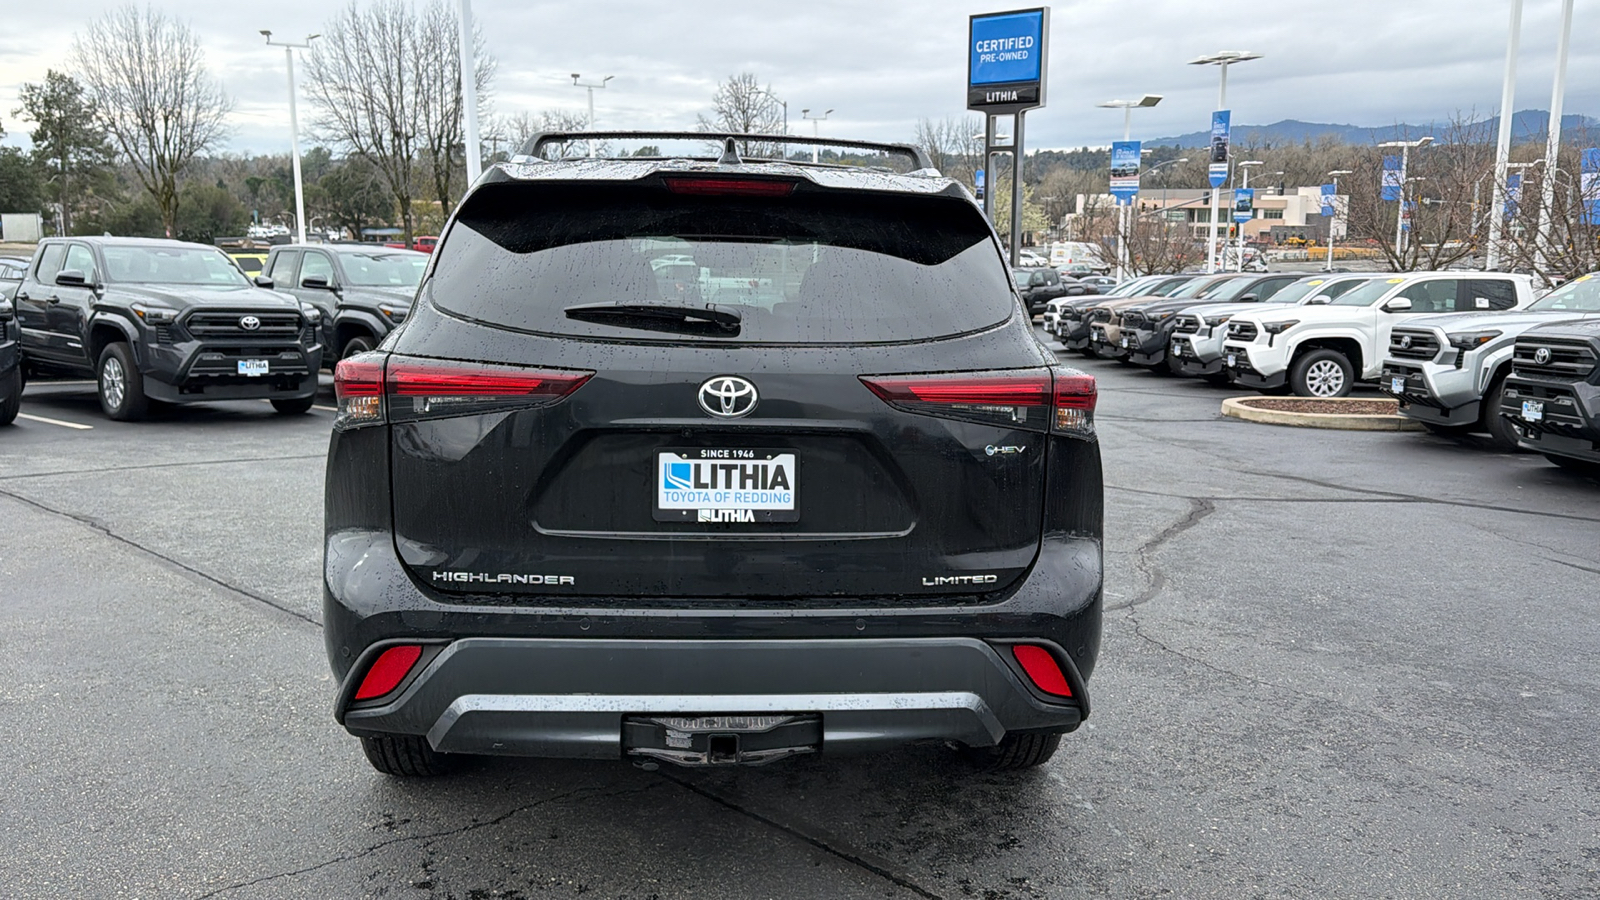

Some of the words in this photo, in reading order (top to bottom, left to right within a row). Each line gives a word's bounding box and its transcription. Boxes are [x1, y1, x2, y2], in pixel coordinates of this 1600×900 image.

[975, 35, 1034, 53] CERTIFIED
[980, 50, 1029, 63] PRE-OWNED
[986, 90, 1018, 103] LITHIA
[700, 449, 730, 458] SINCE
[732, 449, 755, 458] 1946
[994, 445, 1026, 454] HEV
[693, 463, 791, 490] LITHIA
[664, 491, 711, 503] TOYOTA
[714, 491, 731, 503] OF
[734, 492, 791, 504] REDDING
[711, 509, 755, 522] LITHIA
[432, 571, 575, 585] HIGHLANDER
[922, 574, 998, 586] LIMITED
